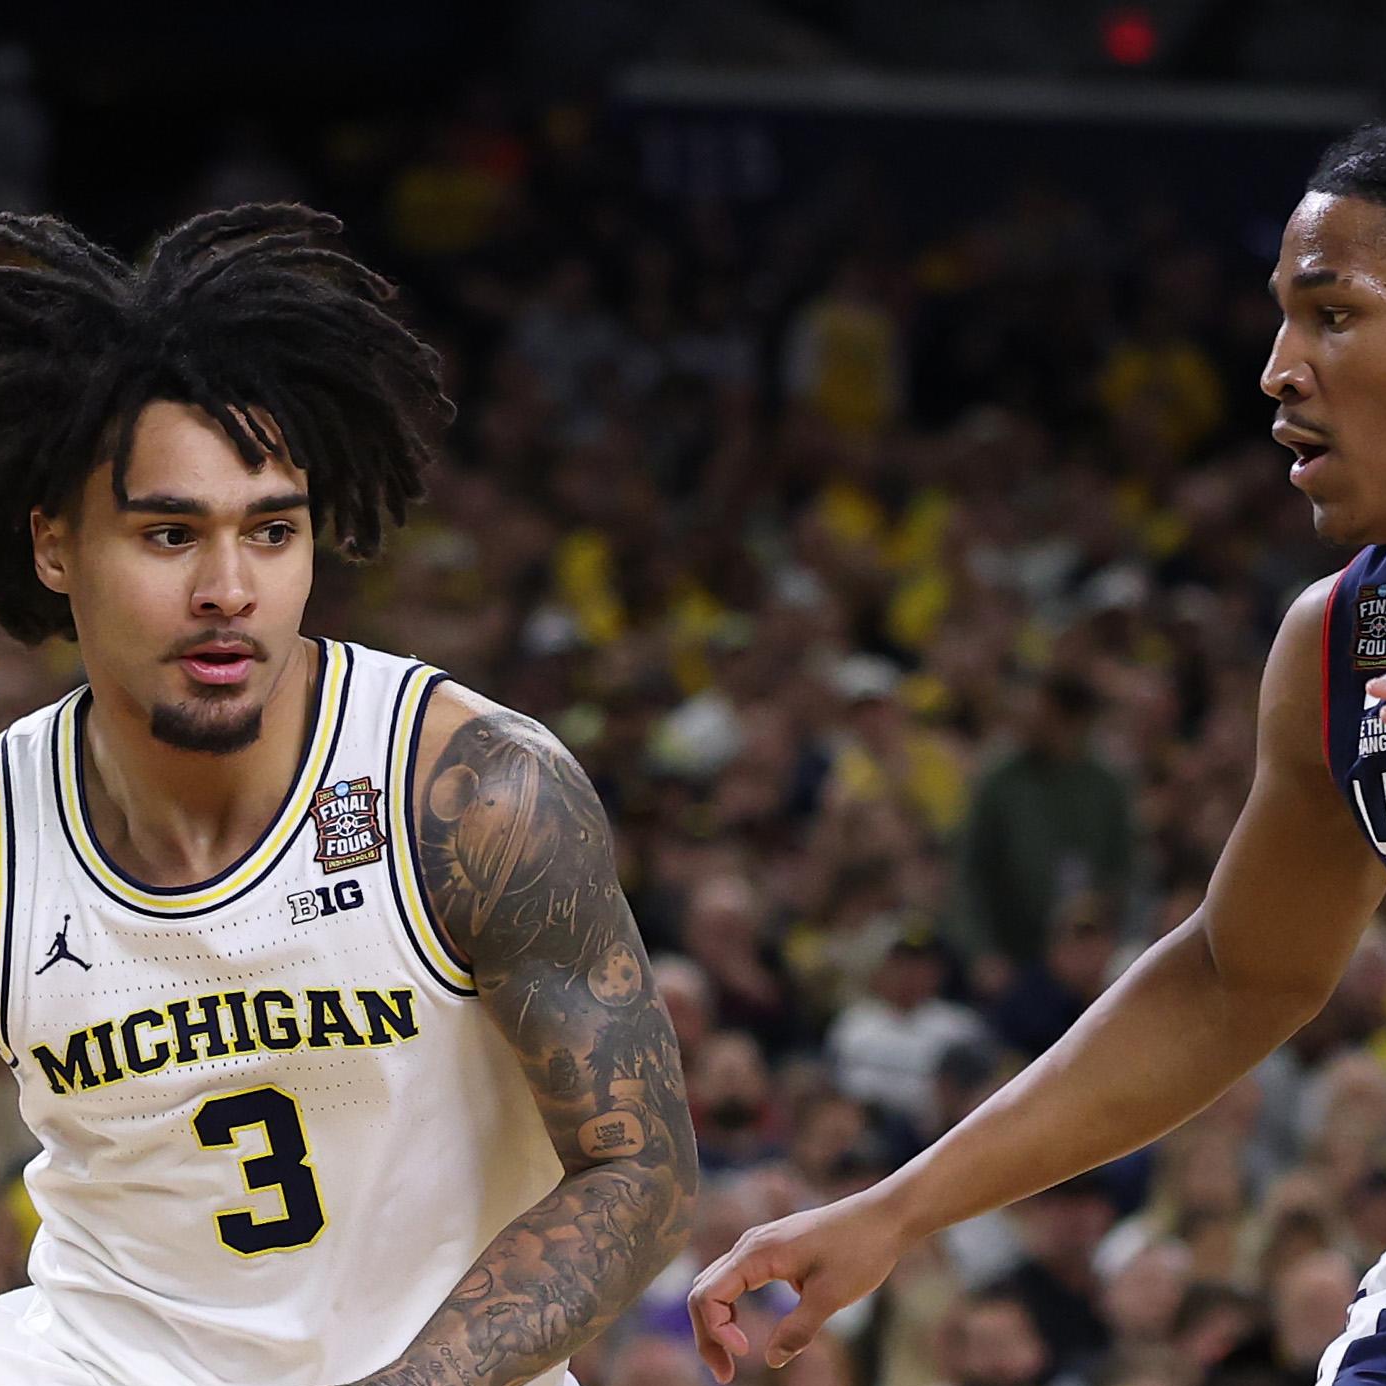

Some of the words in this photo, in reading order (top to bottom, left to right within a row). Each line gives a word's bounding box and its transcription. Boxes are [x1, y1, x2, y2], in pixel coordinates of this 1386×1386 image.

[319, 795, 368, 822] FINAL
[326, 830, 374, 857] FOUR
[29, 986, 421, 1096] MICHIGAN
[189, 1082, 330, 1260] 3
